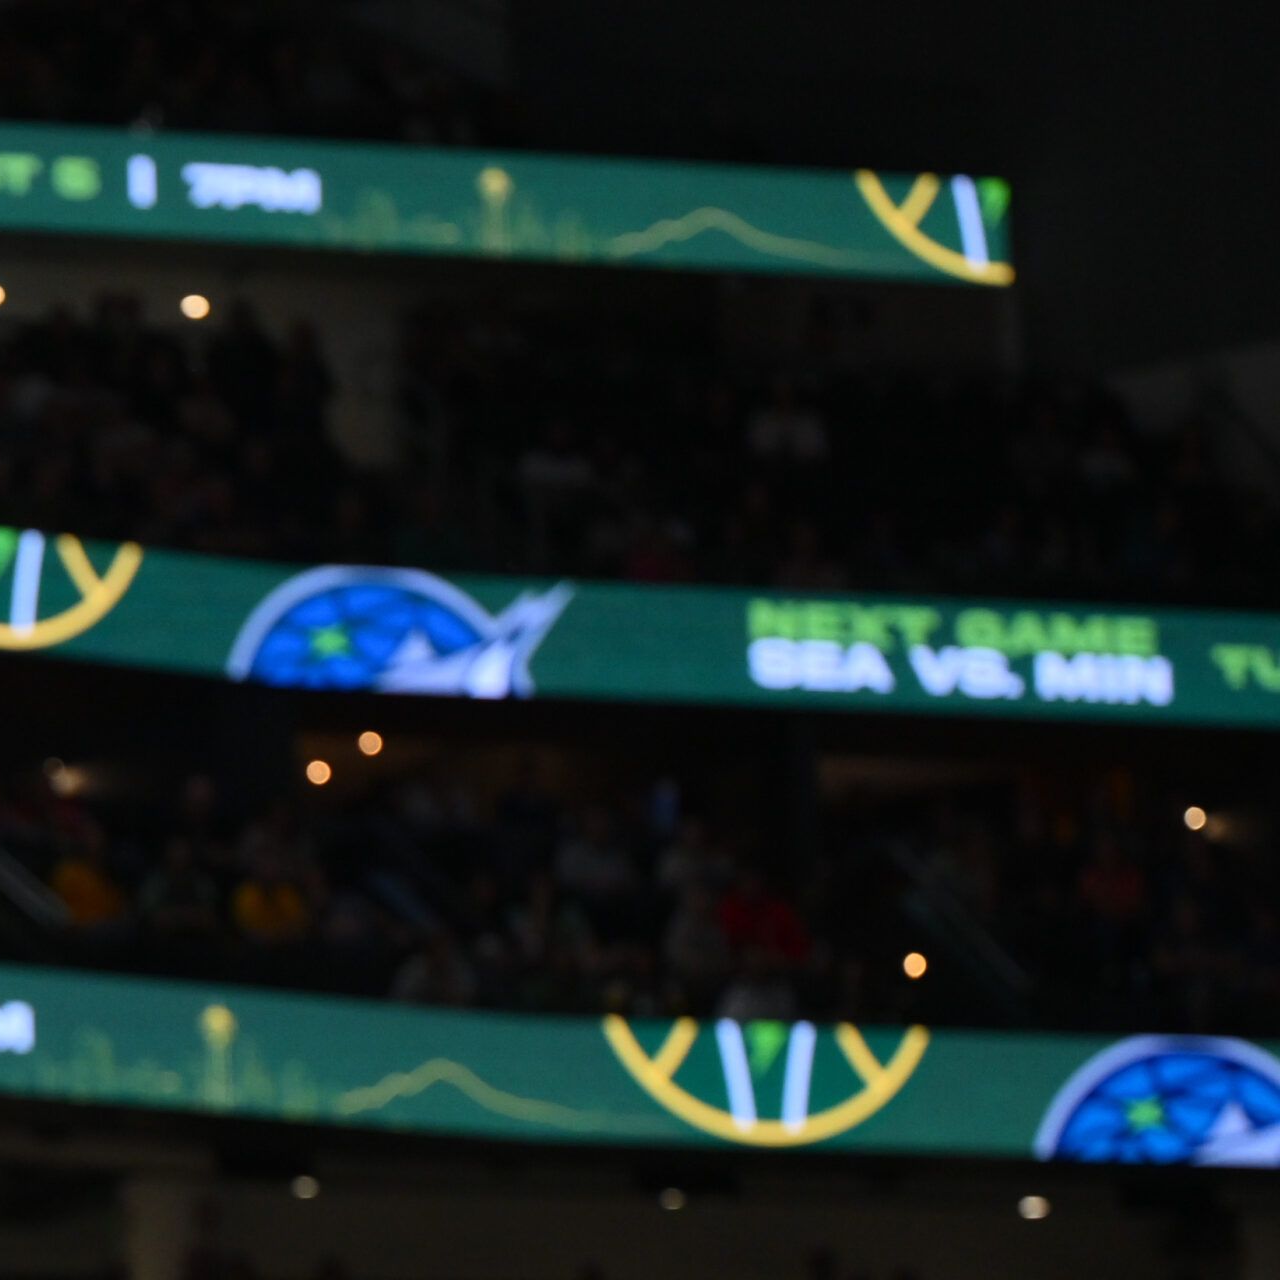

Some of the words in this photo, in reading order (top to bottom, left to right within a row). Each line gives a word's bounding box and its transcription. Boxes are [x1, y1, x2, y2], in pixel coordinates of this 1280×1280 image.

[748, 597, 939, 653] NEXT
[955, 607, 1158, 658] GAME
[747, 637, 896, 694] SEA
[908, 644, 1025, 700] VS.
[1033, 650, 1174, 706] MIN
